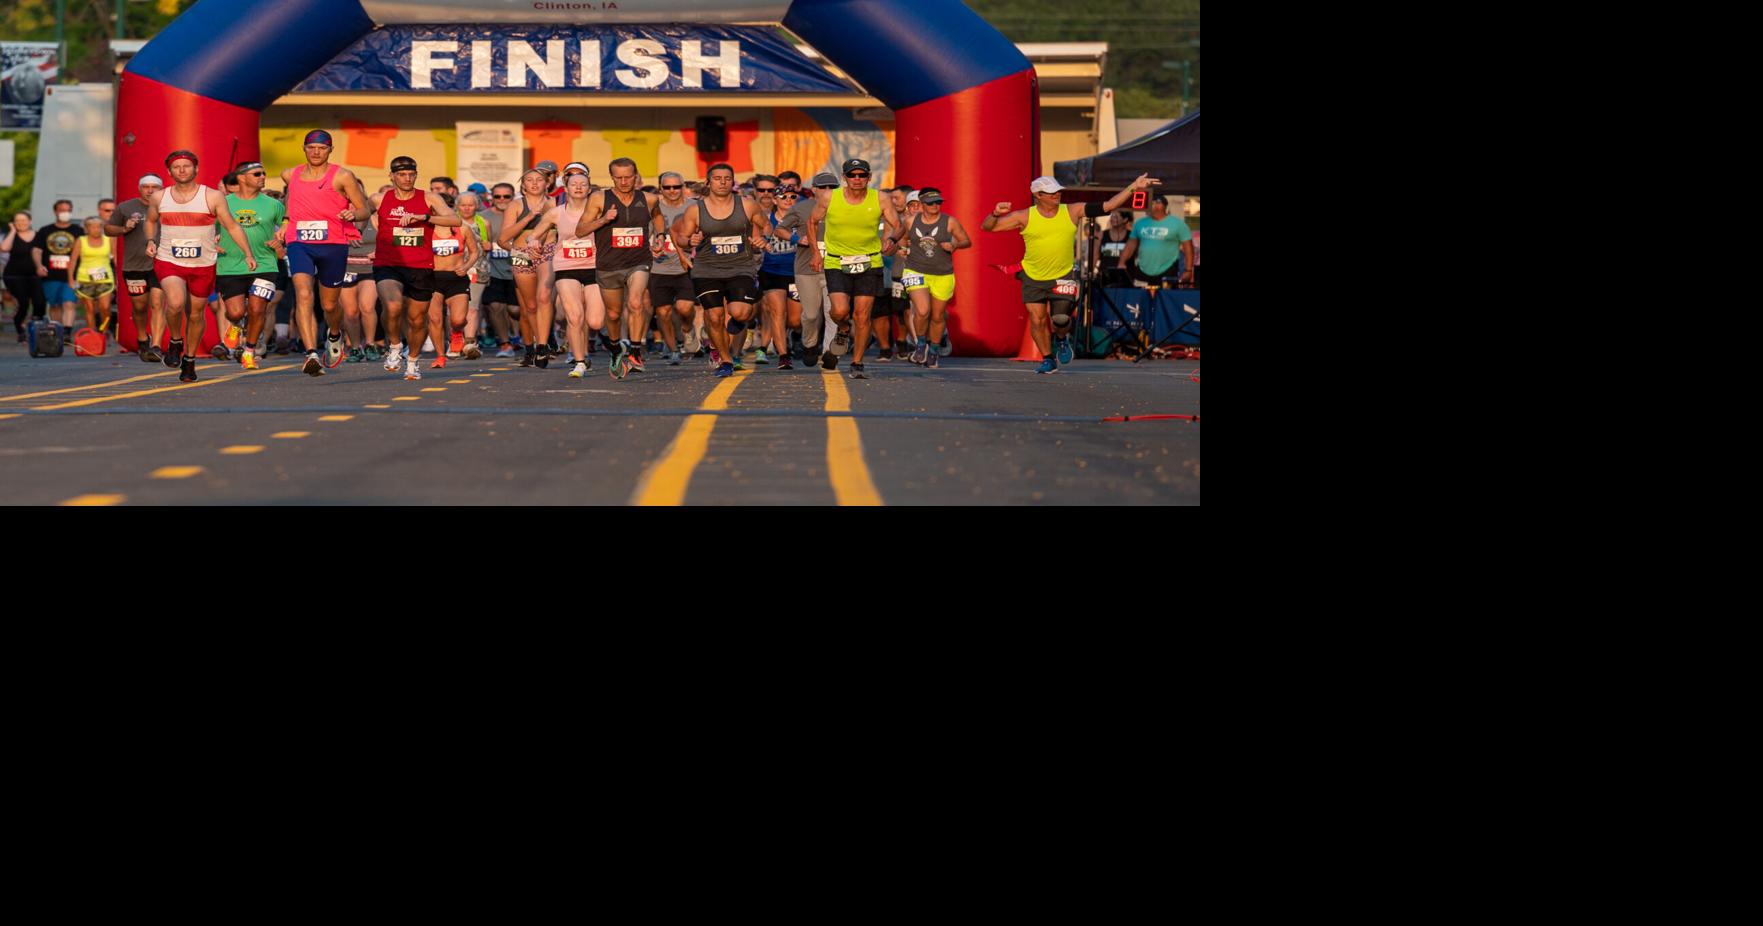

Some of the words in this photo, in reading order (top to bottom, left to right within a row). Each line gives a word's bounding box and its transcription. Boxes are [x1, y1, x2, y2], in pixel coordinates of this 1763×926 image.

[533, 2, 597, 10] Clinton,
[411, 39, 741, 89] FINISH
[300, 229, 324, 240] 320
[398, 236, 418, 246] 121
[616, 236, 640, 247] 394
[174, 247, 198, 257] 260
[435, 247, 455, 256] 251
[567, 248, 588, 258] 415
[715, 244, 738, 254] 306
[848, 263, 865, 273] 29
[253, 286, 273, 300] 301
